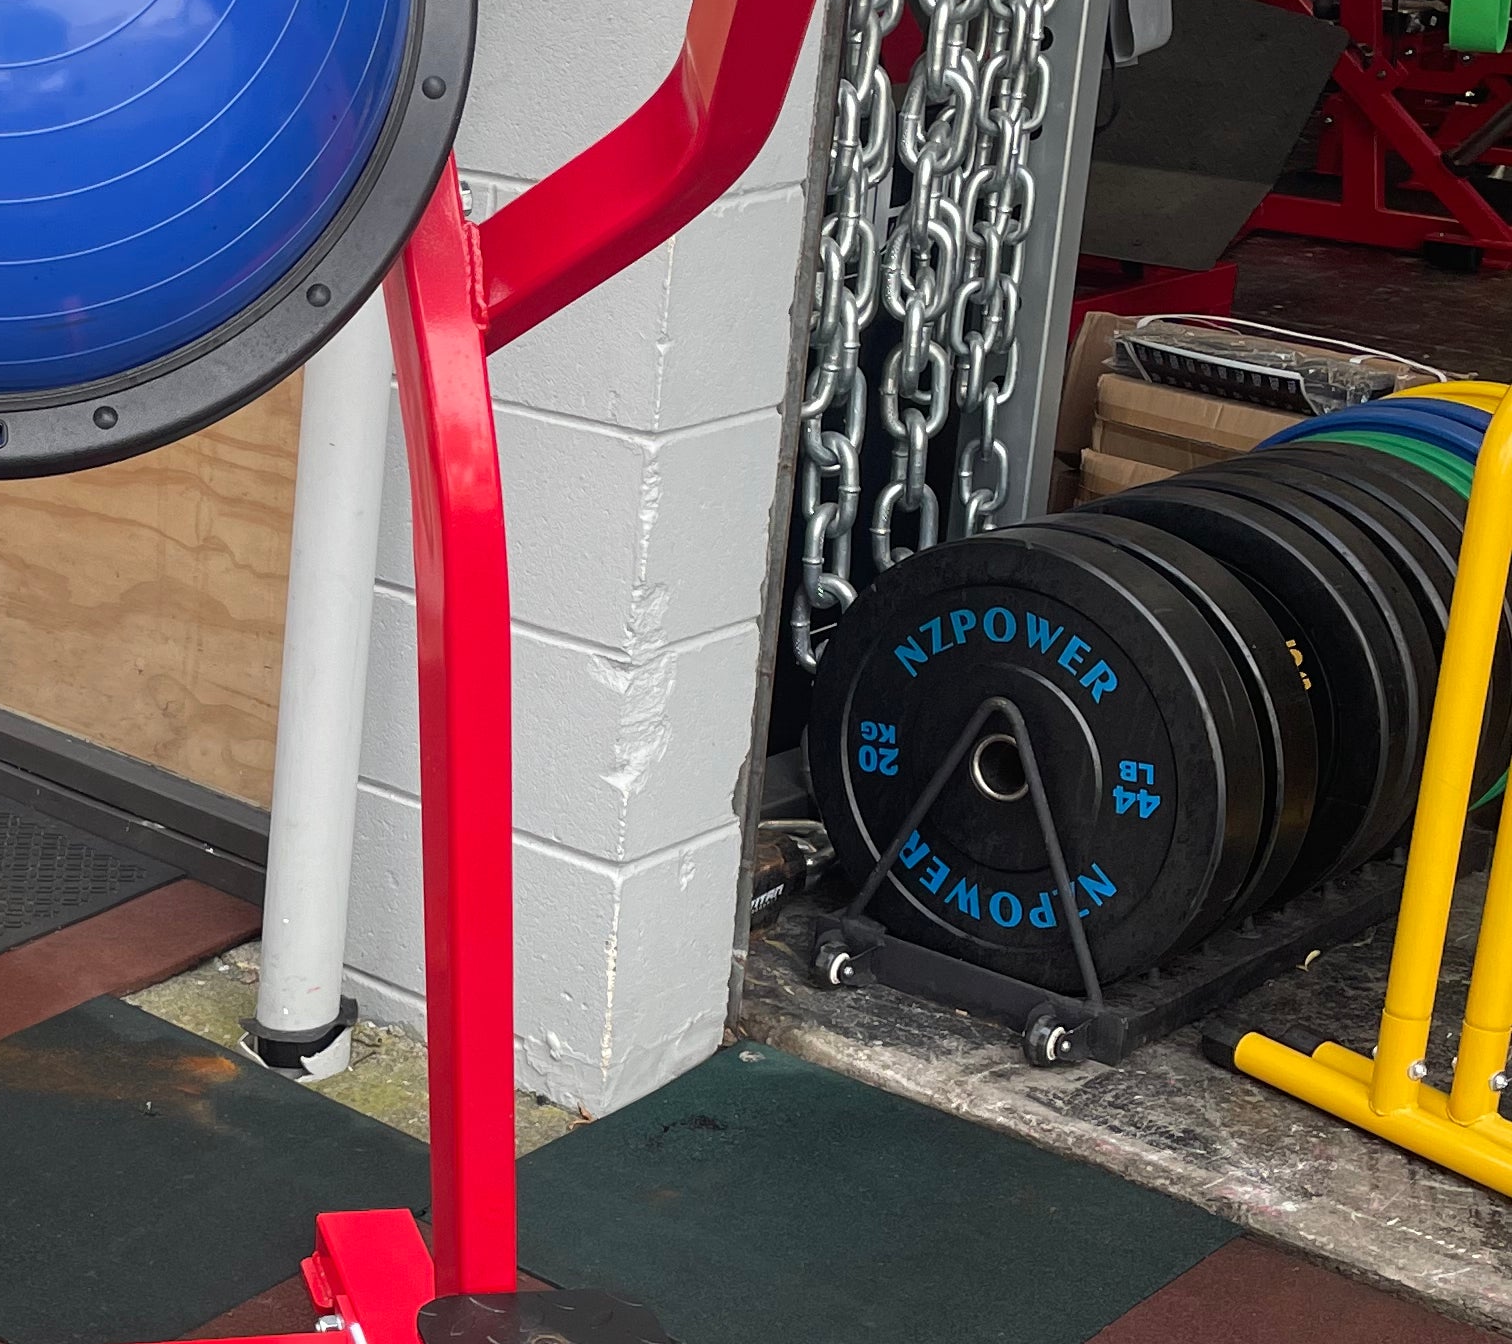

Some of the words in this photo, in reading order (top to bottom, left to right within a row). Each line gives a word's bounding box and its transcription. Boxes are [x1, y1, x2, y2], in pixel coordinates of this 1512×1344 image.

[893, 606, 1119, 704] NZPOWER
[861, 721, 897, 744] KG
[859, 745, 900, 777] 20
[1119, 760, 1155, 785] LB
[1113, 786, 1162, 820] 44
